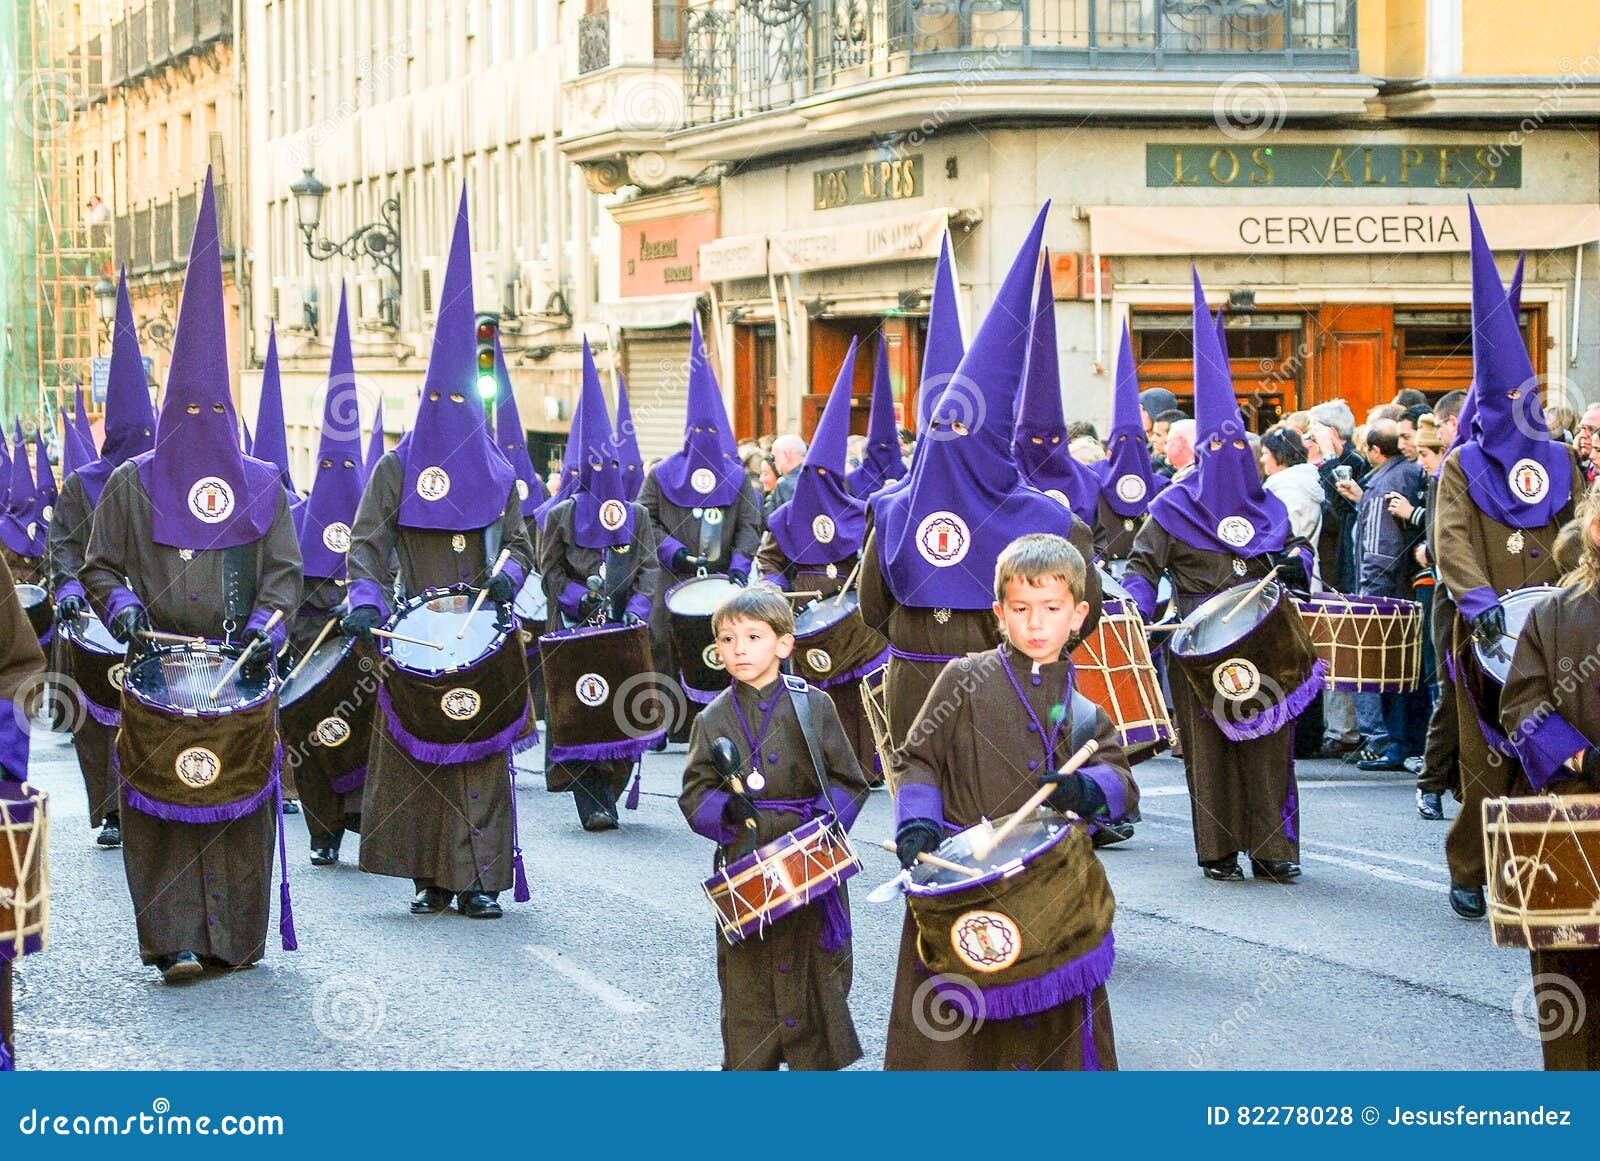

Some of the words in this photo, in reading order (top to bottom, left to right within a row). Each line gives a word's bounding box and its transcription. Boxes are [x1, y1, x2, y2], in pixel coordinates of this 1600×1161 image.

[815, 170, 848, 209] LOS
[863, 160, 914, 199] ALPES
[1174, 147, 1275, 184] LOS
[1326, 147, 1497, 185] ALPES
[1239, 216, 1459, 244] CERVECERIA
